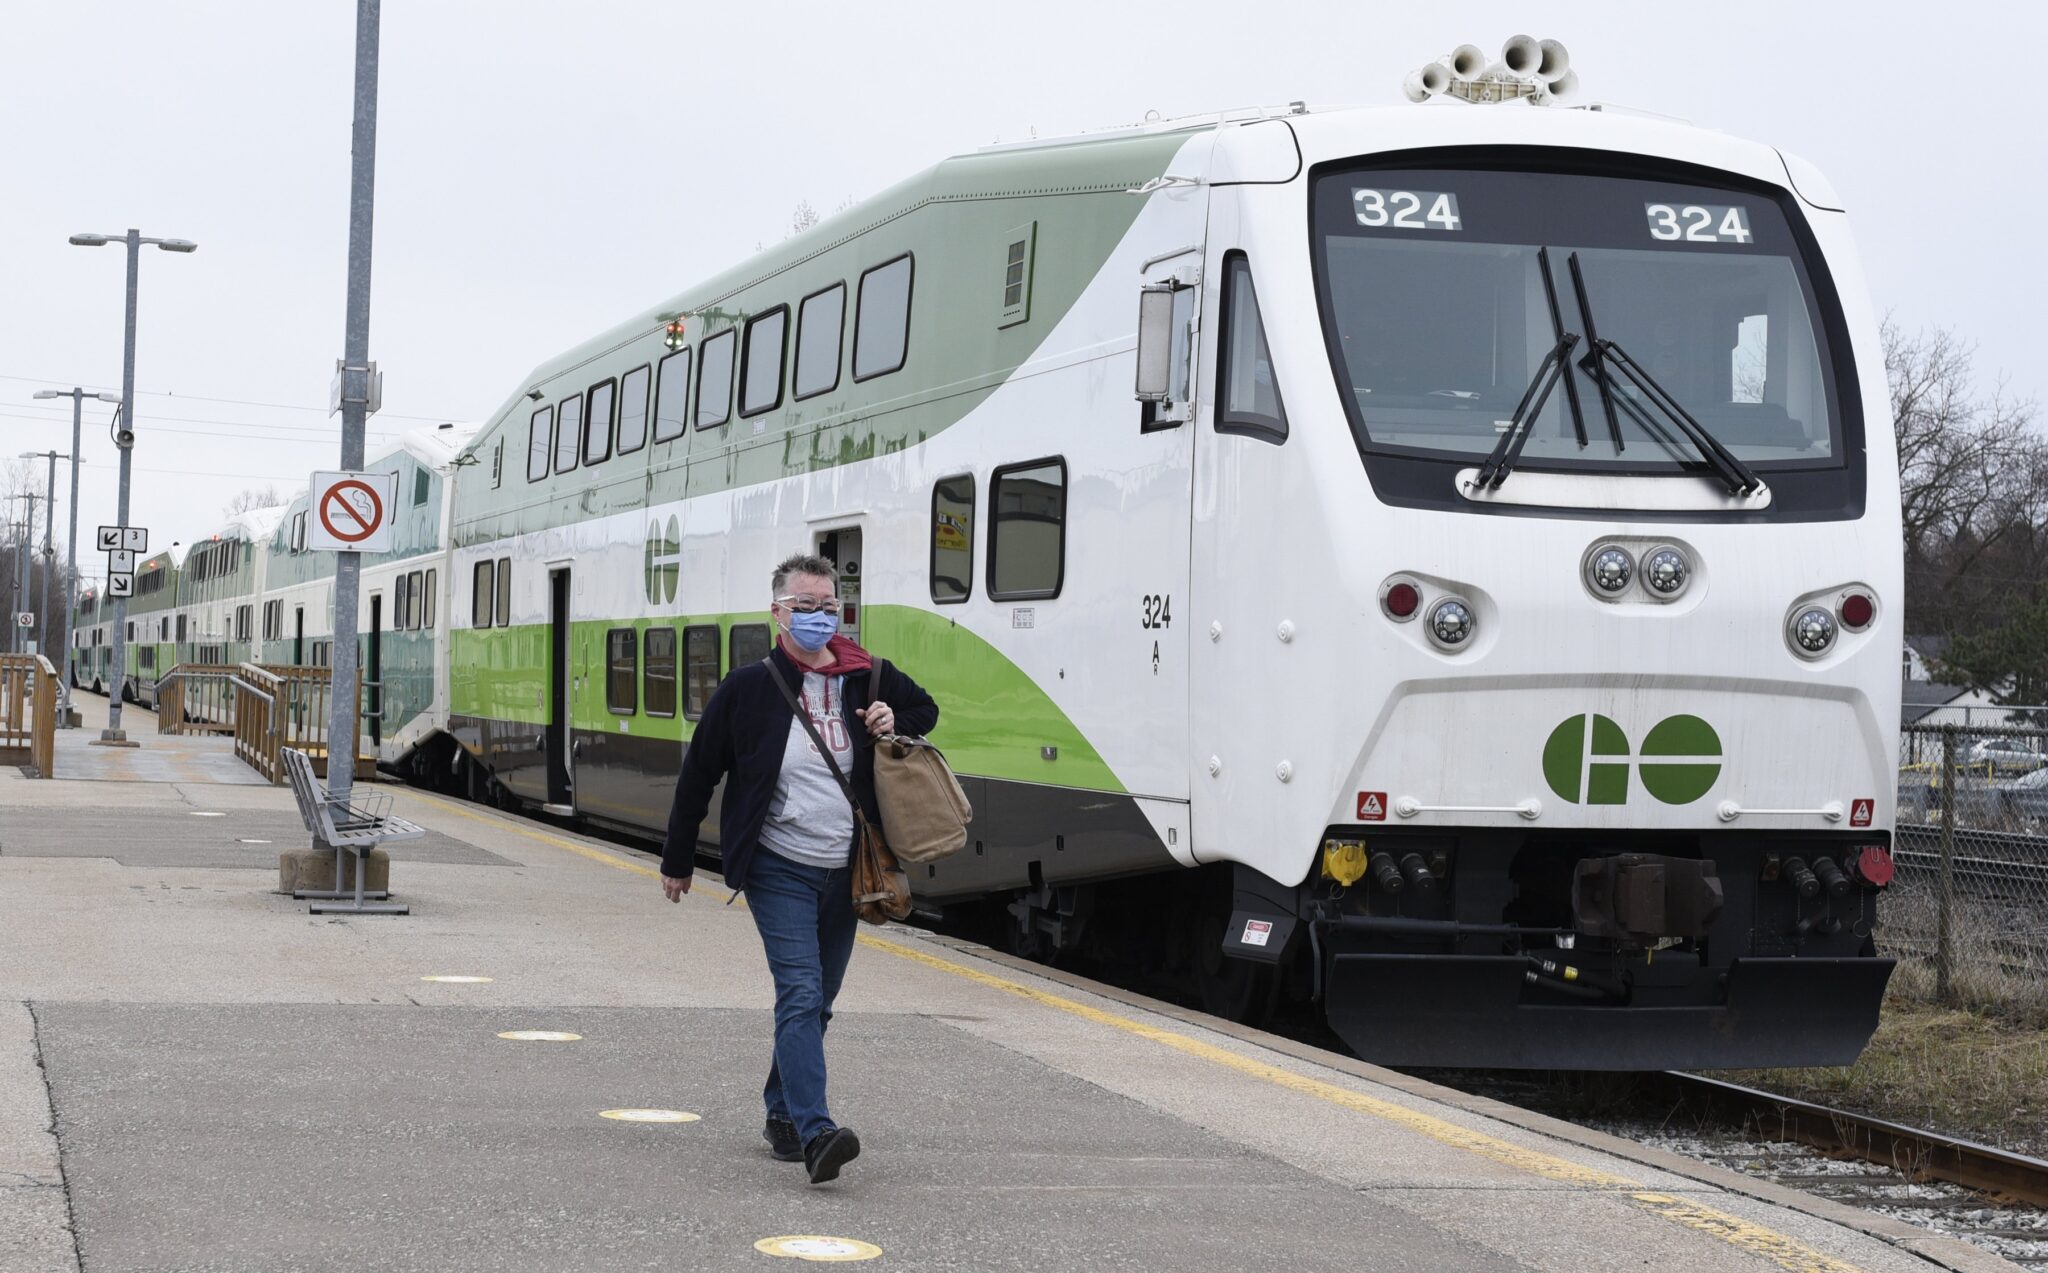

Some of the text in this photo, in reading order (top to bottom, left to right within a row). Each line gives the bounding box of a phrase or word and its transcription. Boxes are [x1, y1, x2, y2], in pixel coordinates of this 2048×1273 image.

[1354, 189, 1459, 230] 324
[1647, 204, 1750, 243] 324
[132, 531, 138, 540] 3
[118, 552, 125, 560] 4
[1142, 594, 1171, 629] 324
[1152, 640, 1160, 663] A
[1153, 663, 1158, 676] R
[1542, 713, 1723, 805] GO
